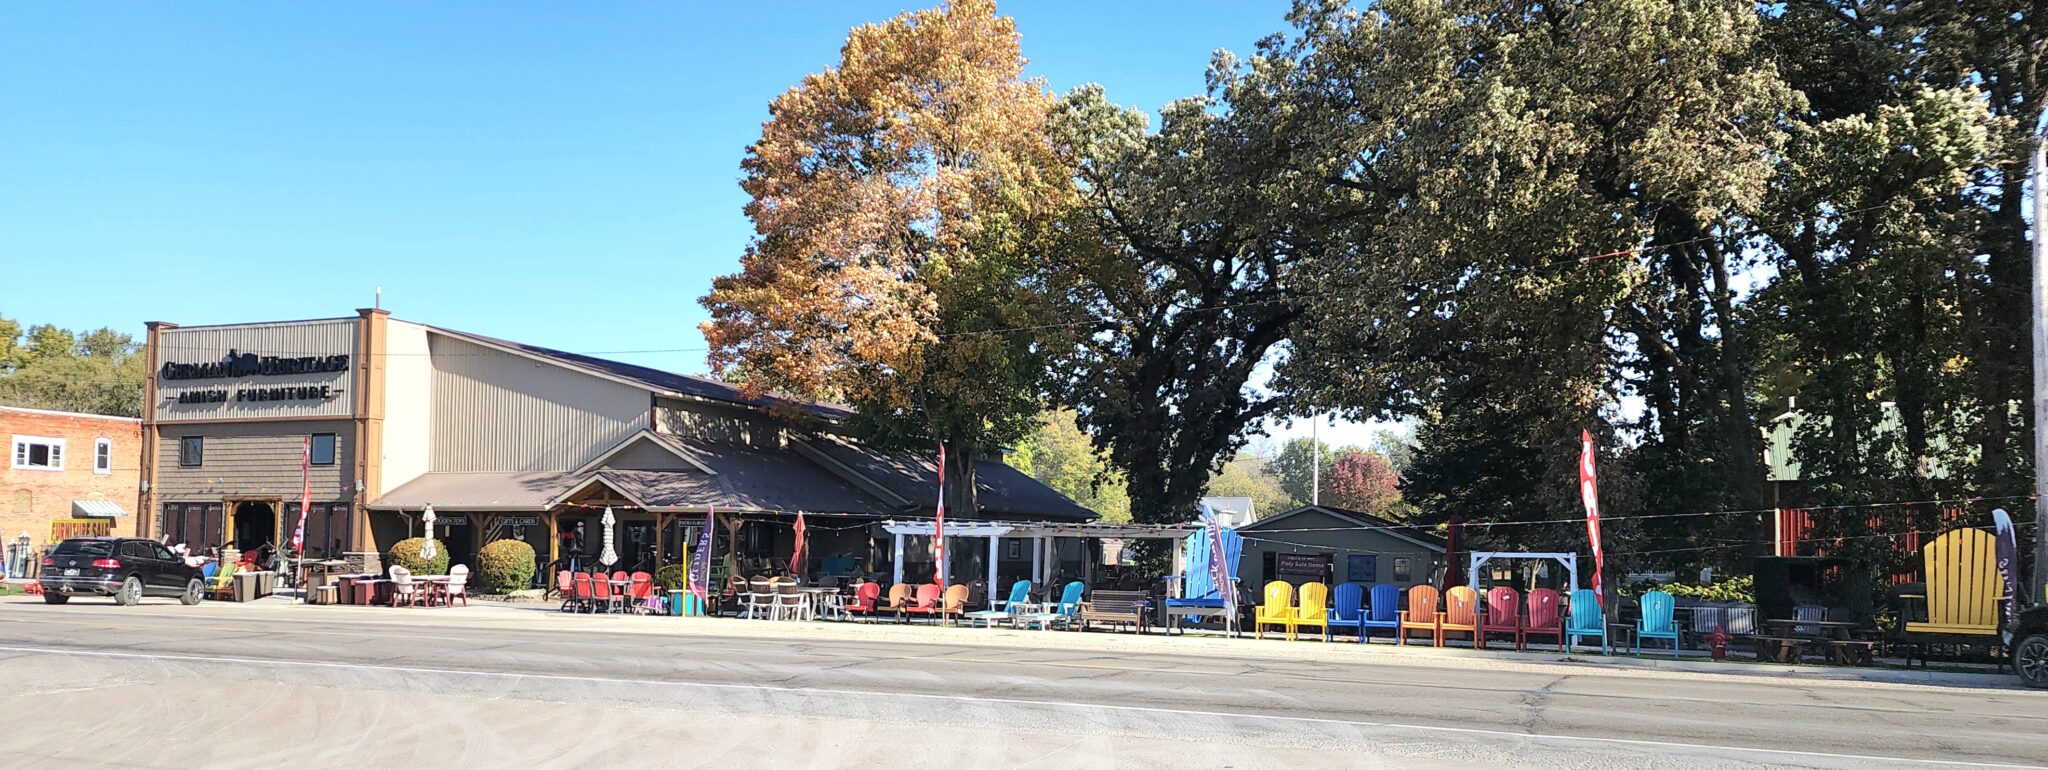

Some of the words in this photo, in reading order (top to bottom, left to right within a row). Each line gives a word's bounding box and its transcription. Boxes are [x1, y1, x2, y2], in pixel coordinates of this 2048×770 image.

[178, 388, 228, 404] AMISH
[236, 385, 330, 402] FURNITURE
[51, 522, 91, 541] FURNITURE
